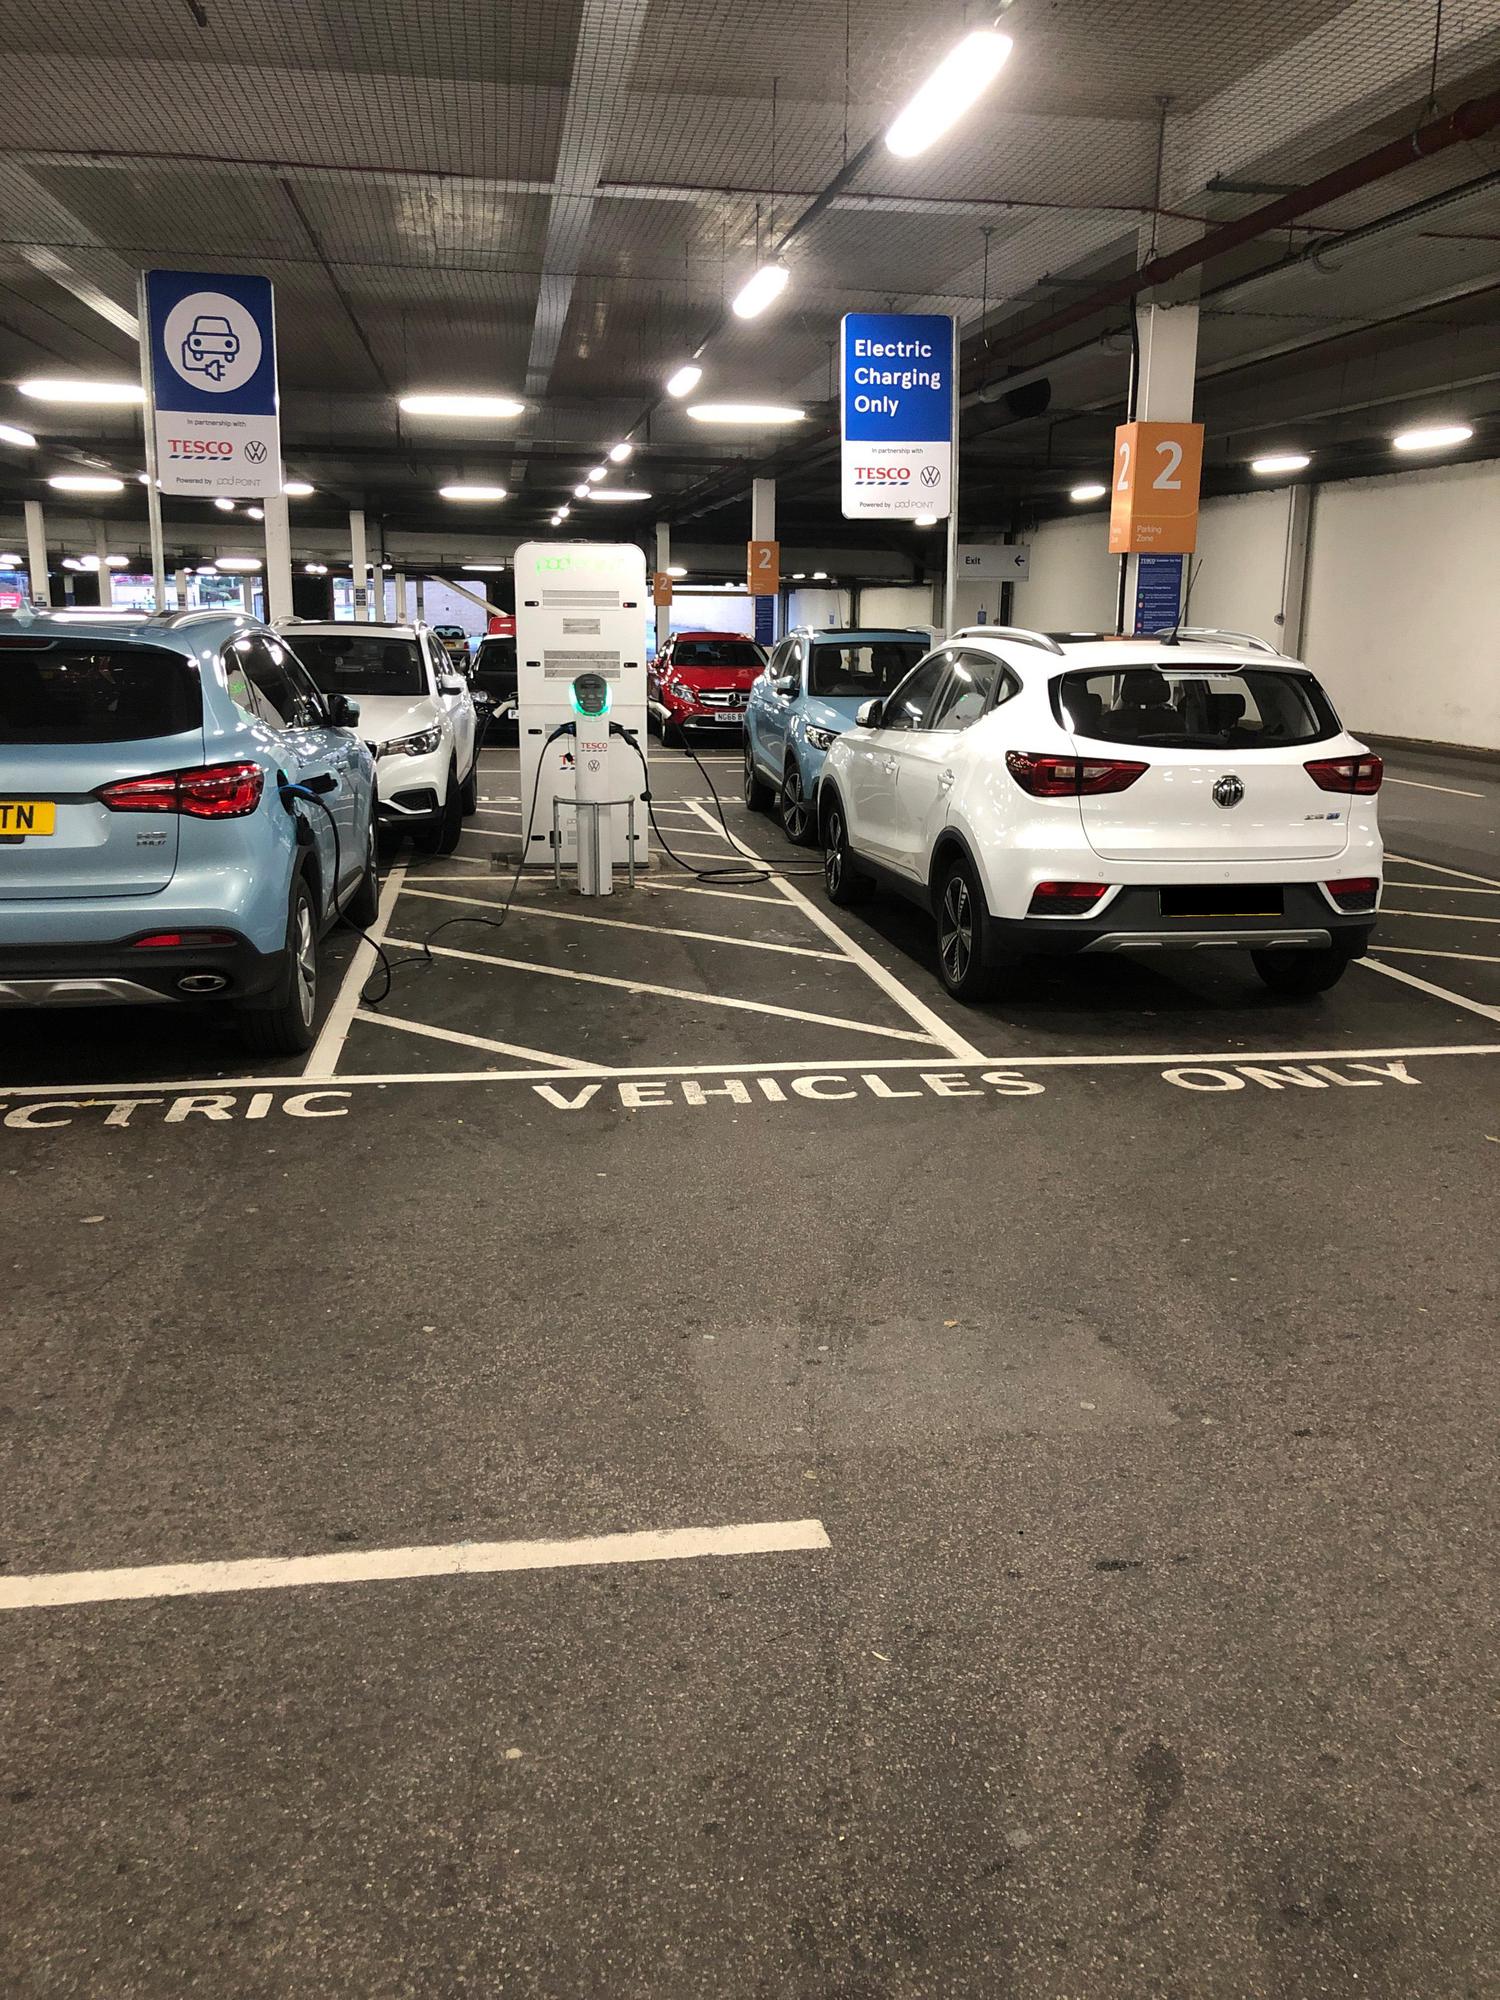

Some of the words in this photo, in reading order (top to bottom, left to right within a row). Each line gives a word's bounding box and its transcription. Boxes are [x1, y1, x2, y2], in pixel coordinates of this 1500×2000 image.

[854, 339, 932, 357] Electric
[854, 367, 941, 390] Charging
[854, 395, 899, 417] Only
[194, 419, 232, 428] partnership
[167, 439, 233, 455] TESCO
[878, 447, 910, 455] partnership
[1117, 442, 1131, 491] 2
[1152, 440, 1183, 490] 2
[854, 467, 911, 480] TESCO
[176, 476, 203, 484] Powered
[204, 477, 212, 486] by
[884, 501, 891, 509] by
[1136, 525, 1162, 535] Parking
[1136, 534, 1154, 542] Zone
[758, 548, 772, 569] 2
[965, 556, 981, 565] Exit
[660, 577, 668, 590] 2
[0, 805, 34, 829] TN
[0, 1091, 353, 1128] CTRIC
[531, 1070, 1046, 1110] VEHICLES
[1160, 1060, 1423, 1092] ONLY
